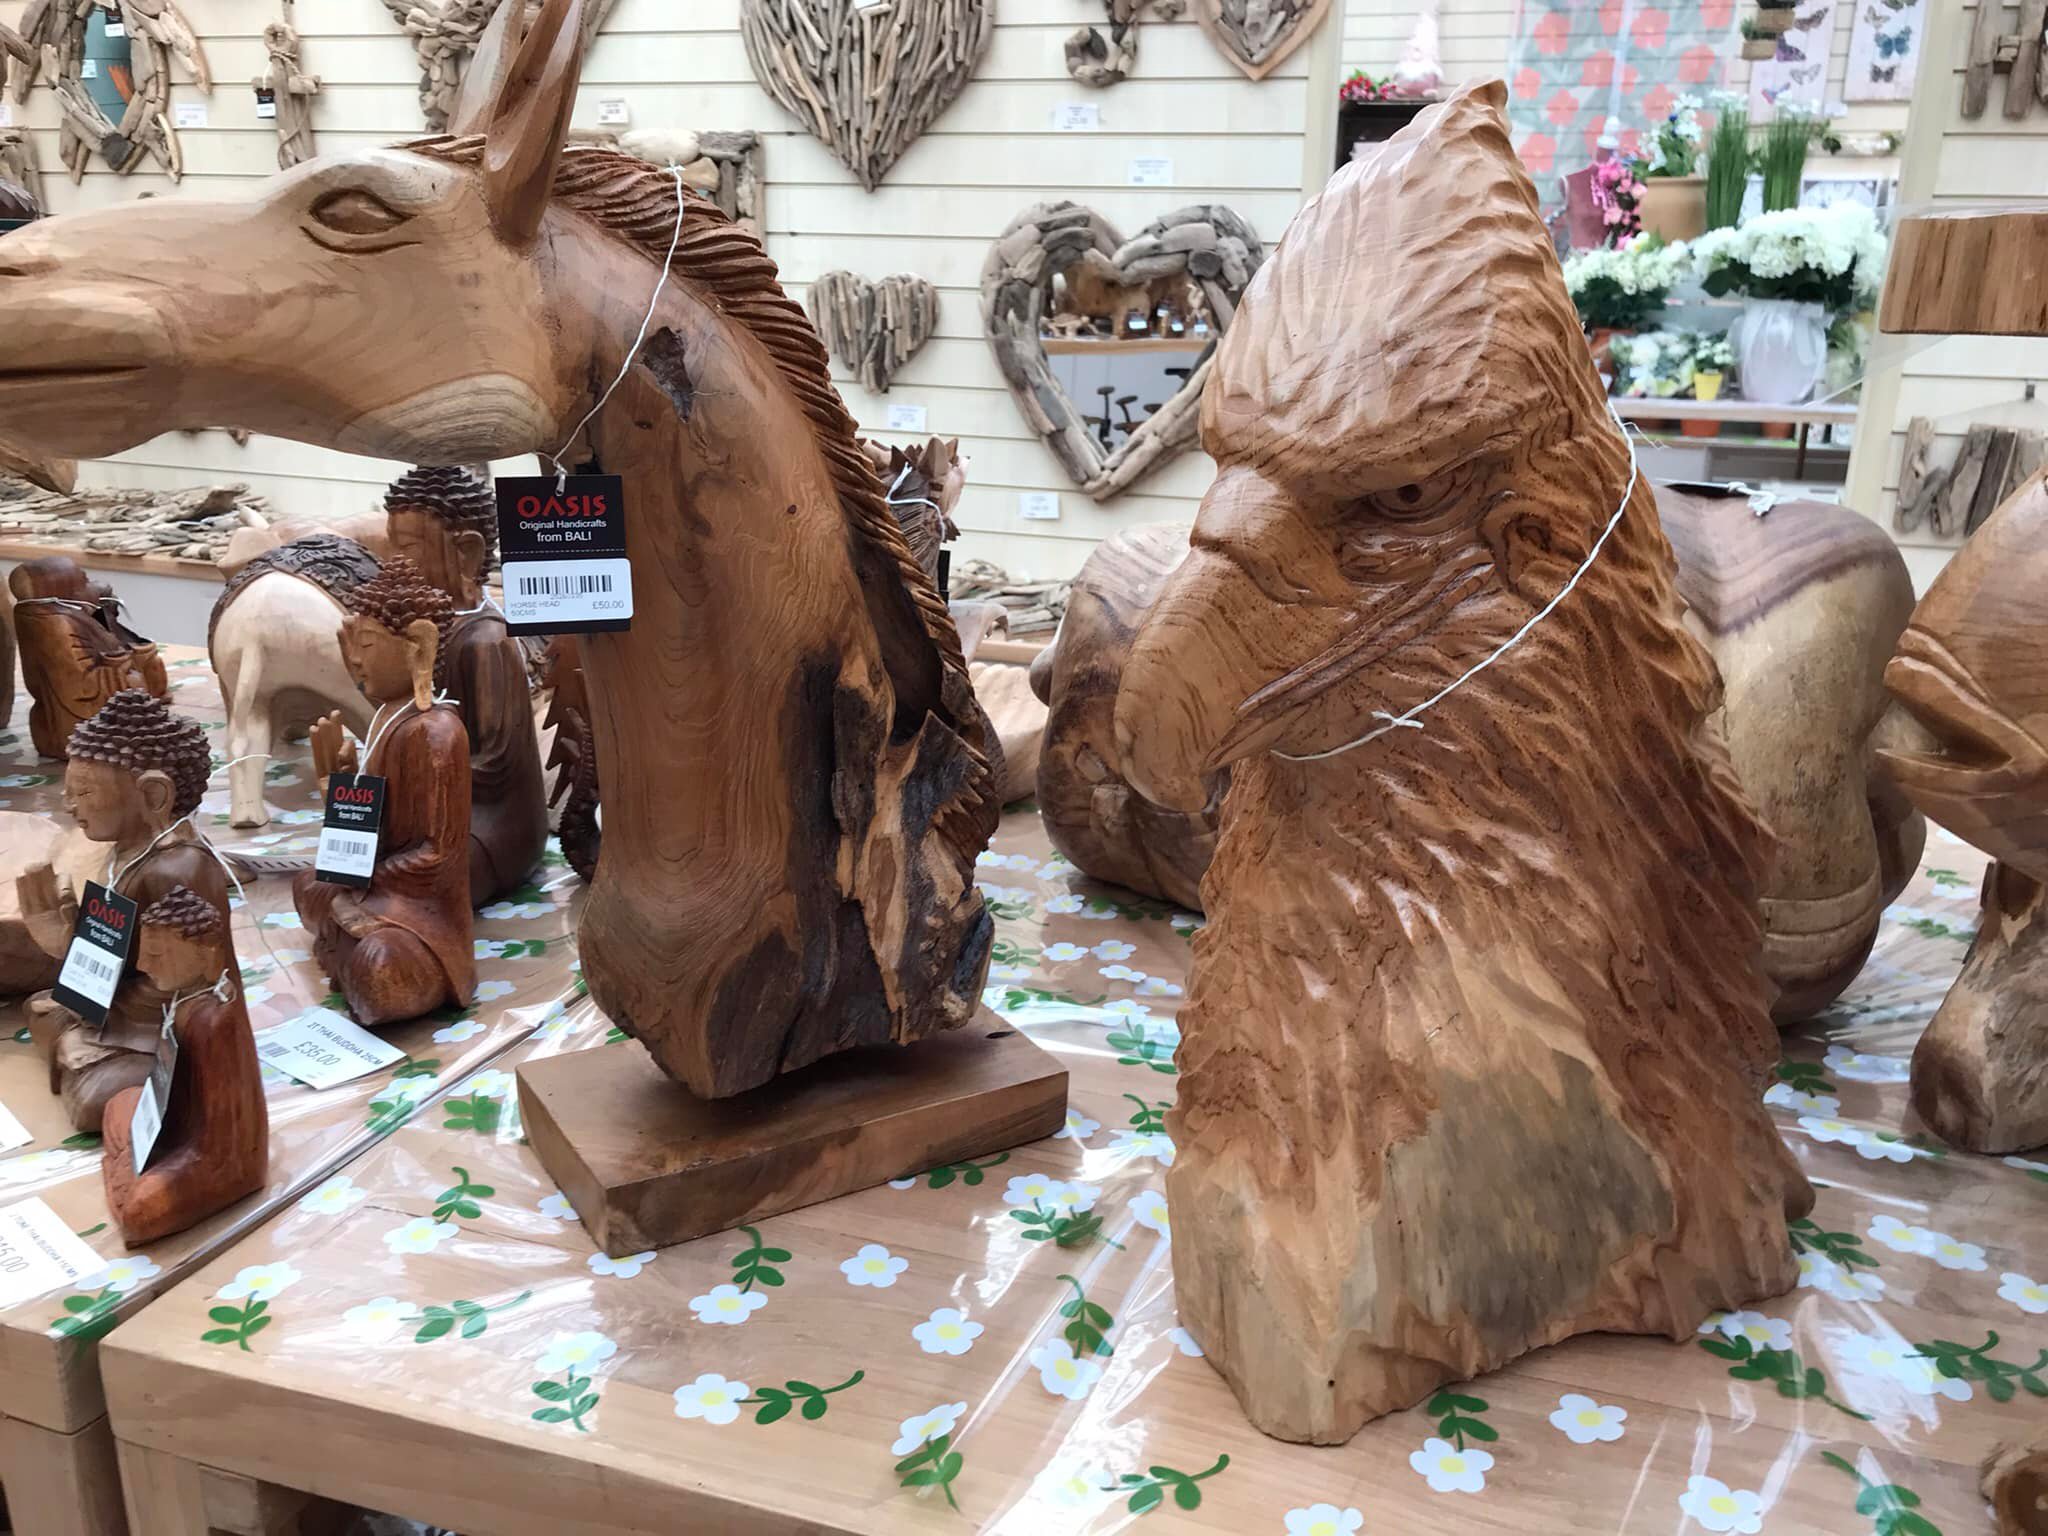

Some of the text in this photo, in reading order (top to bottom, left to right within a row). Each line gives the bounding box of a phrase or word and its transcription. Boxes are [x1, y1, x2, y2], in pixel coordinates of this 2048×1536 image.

[516, 495, 608, 518] OASIS
[519, 519, 607, 531] Original Handicrafts
[537, 531, 592, 543] from BALI
[510, 600, 560, 609] HORSE HEAD
[592, 600, 624, 610] £50.00
[334, 785, 375, 804] OASIS
[88, 898, 126, 929] OASIS
[316, 1025, 335, 1040] THAI
[331, 1034, 364, 1056] BUDDHA
[293, 1041, 342, 1066] £35.00
